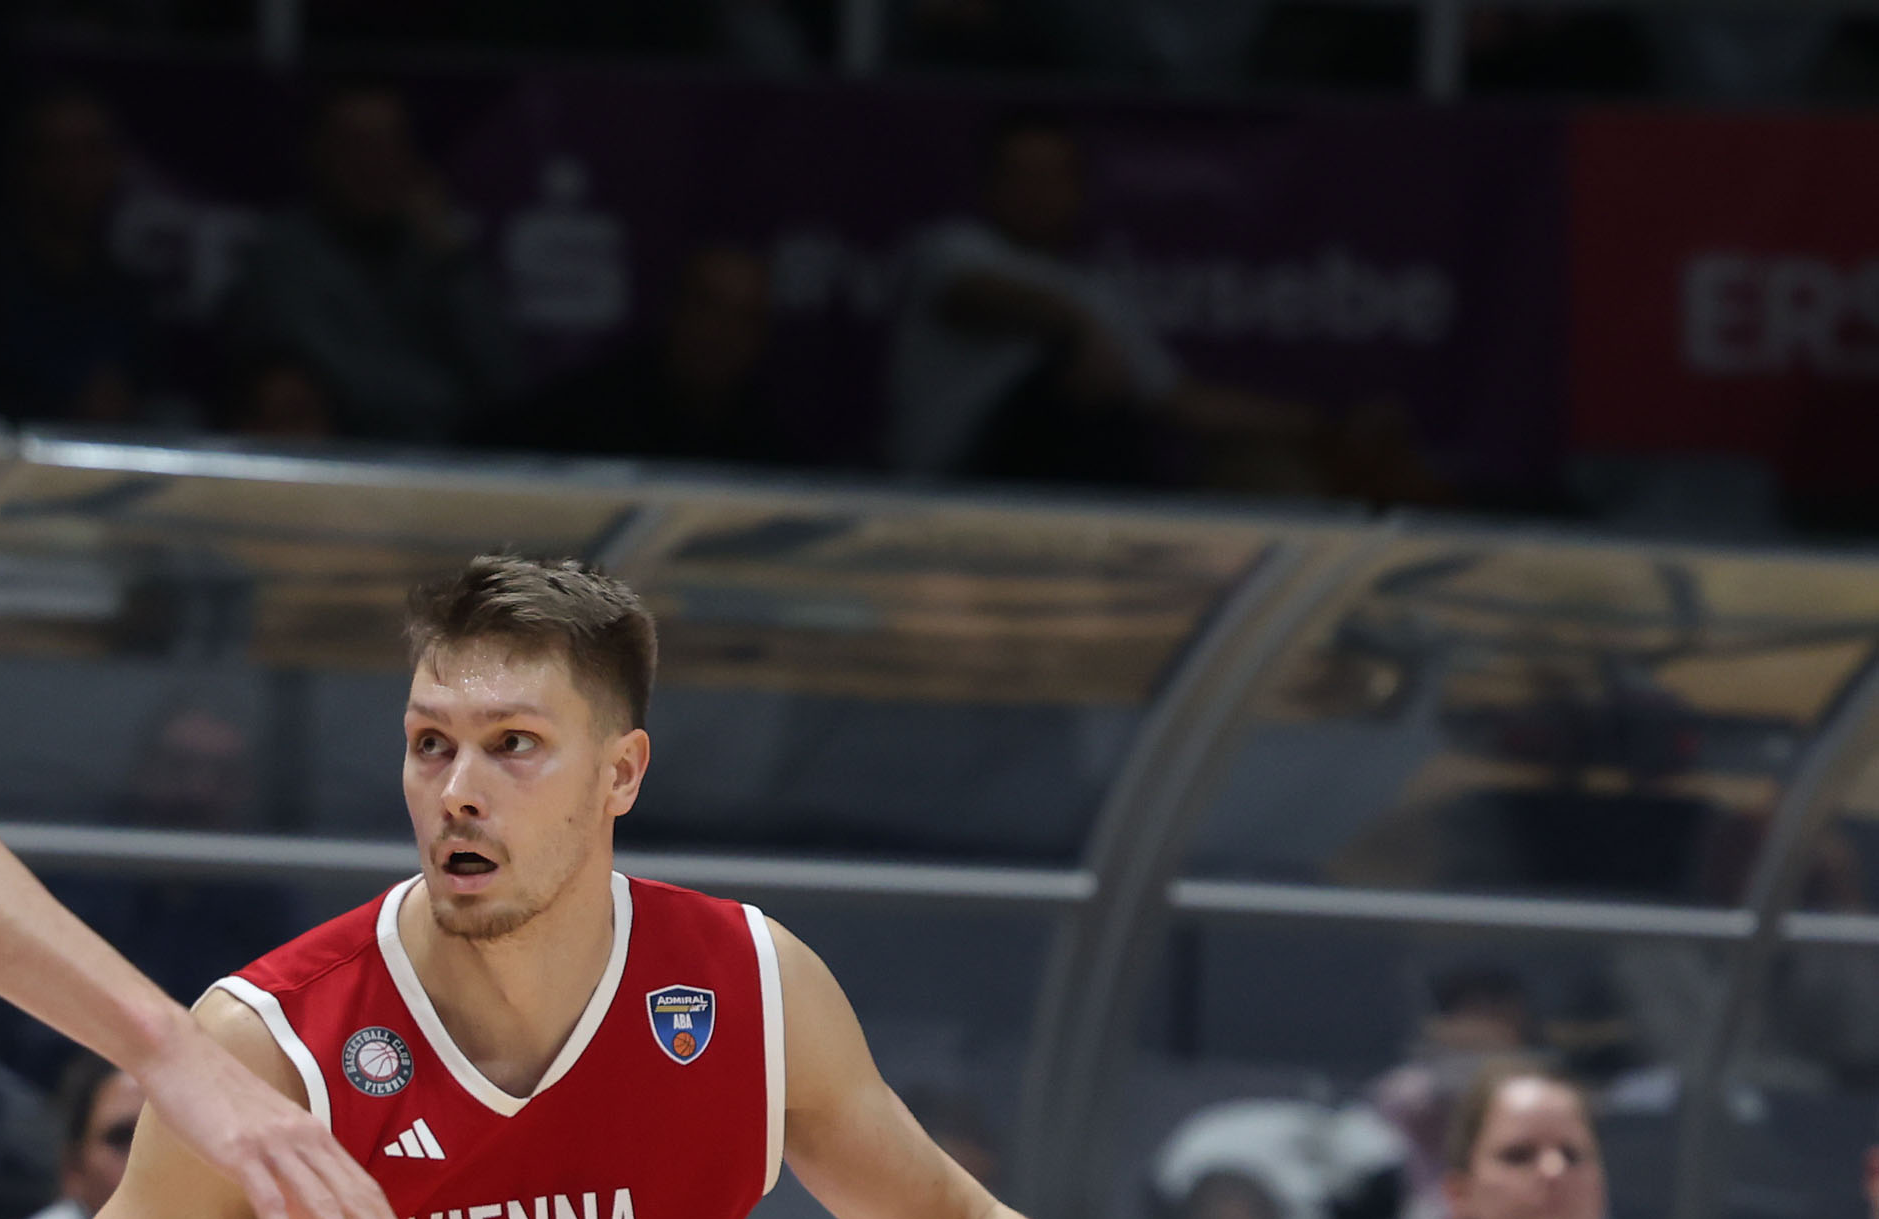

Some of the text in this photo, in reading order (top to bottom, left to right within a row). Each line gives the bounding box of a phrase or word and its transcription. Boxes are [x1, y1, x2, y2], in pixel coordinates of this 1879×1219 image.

[657, 994, 708, 1006] ADMIRAL
[673, 1013, 694, 1030] ABA
[345, 1030, 411, 1074] BASKETBALL CLUB
[364, 1076, 406, 1094] VIENNA
